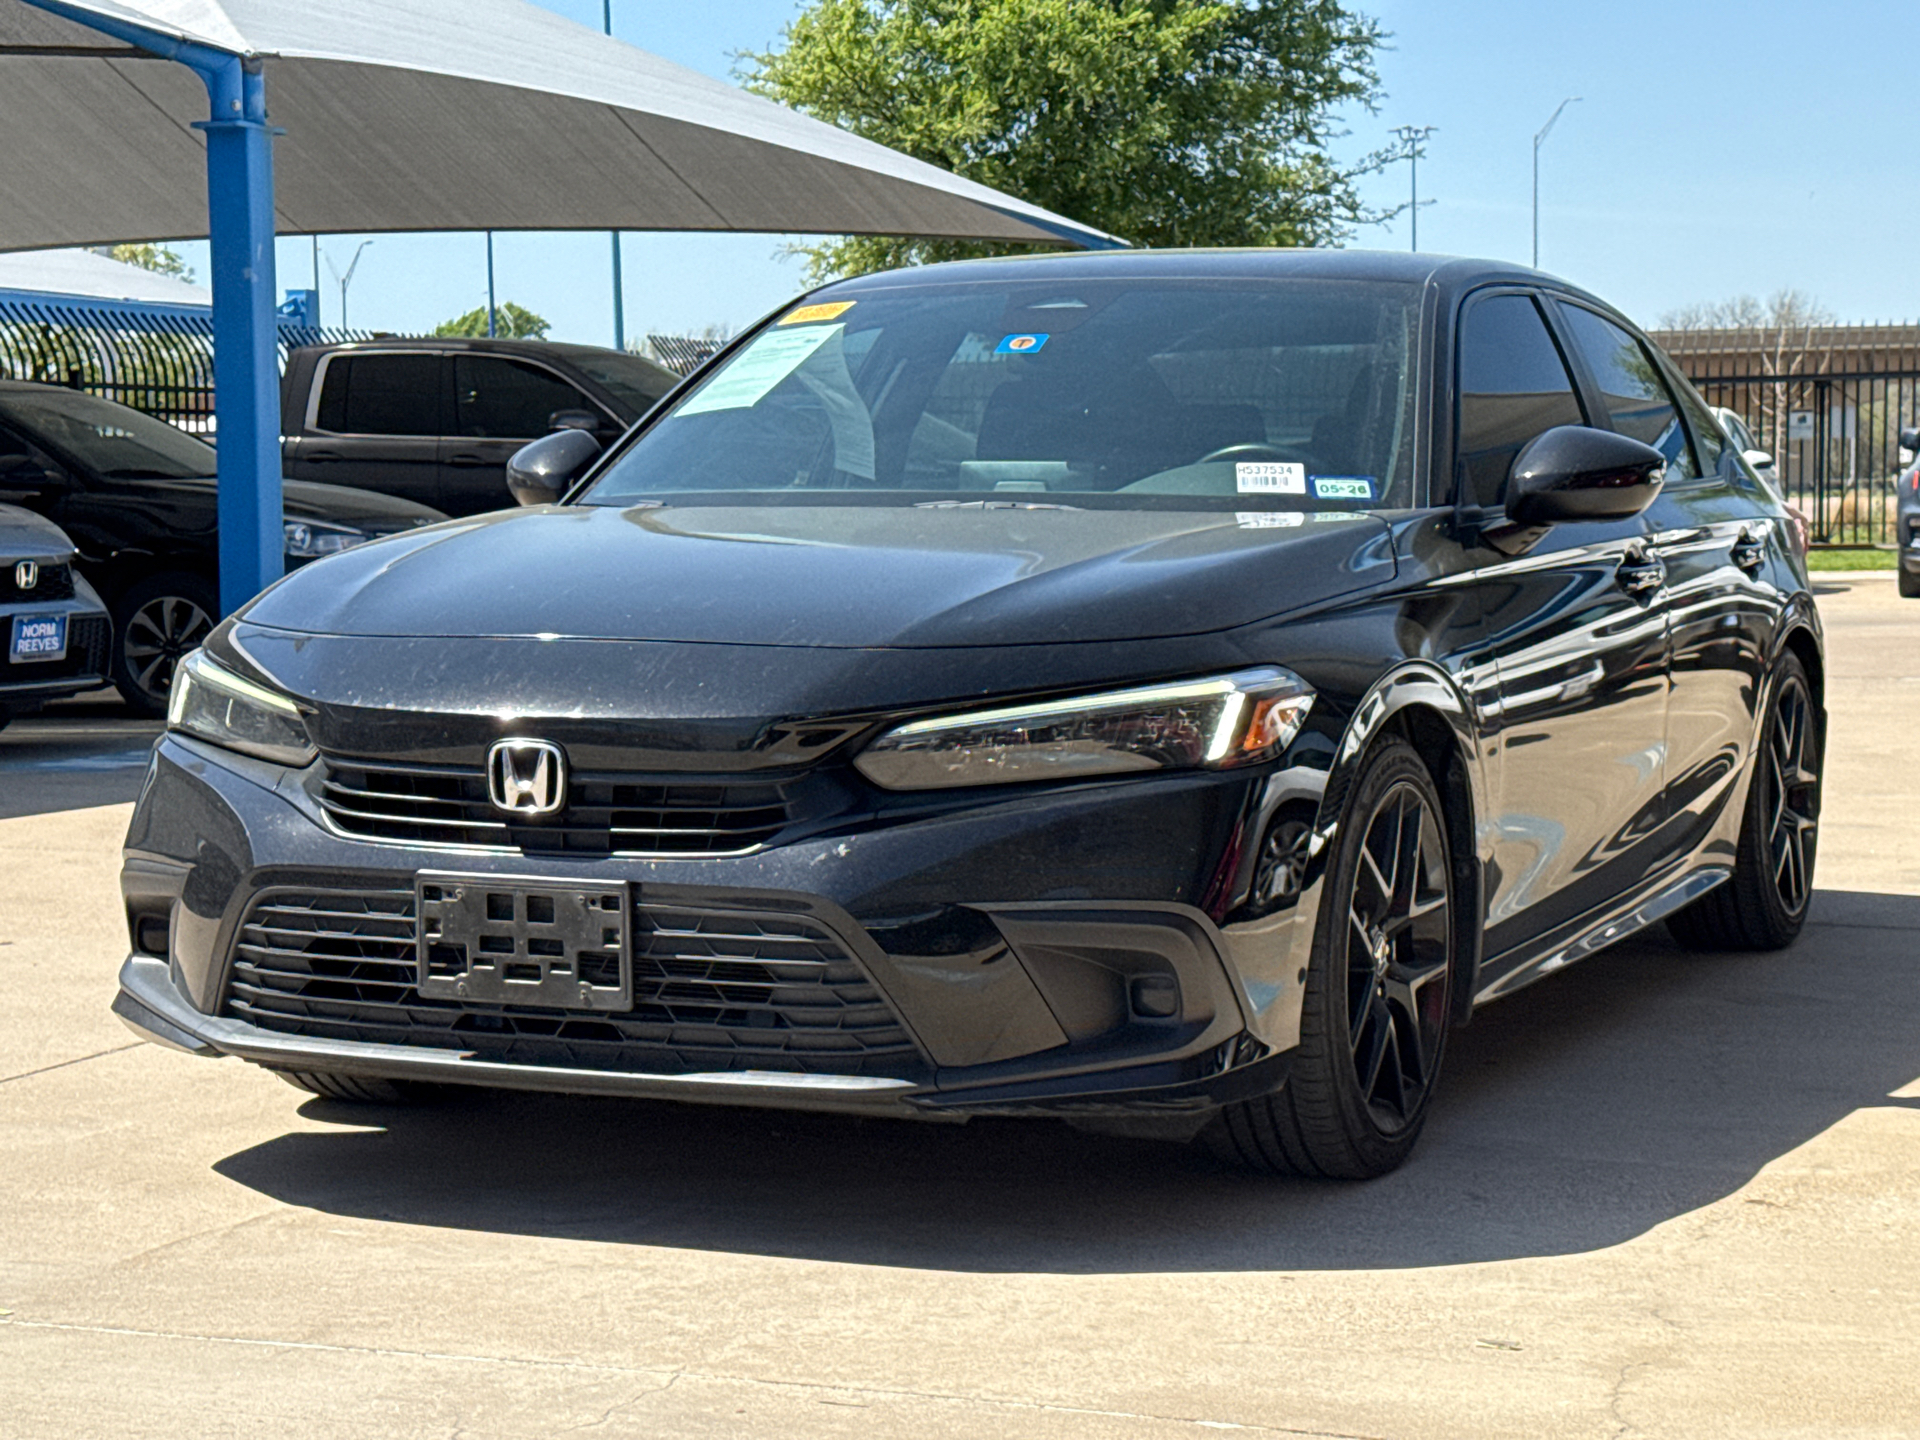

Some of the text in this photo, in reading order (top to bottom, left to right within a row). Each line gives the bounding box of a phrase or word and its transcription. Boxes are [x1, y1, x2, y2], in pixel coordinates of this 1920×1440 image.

[1238, 466, 1293, 475] H537534
[21, 622, 57, 639] NORM
[16, 636, 60, 654] REEVES
